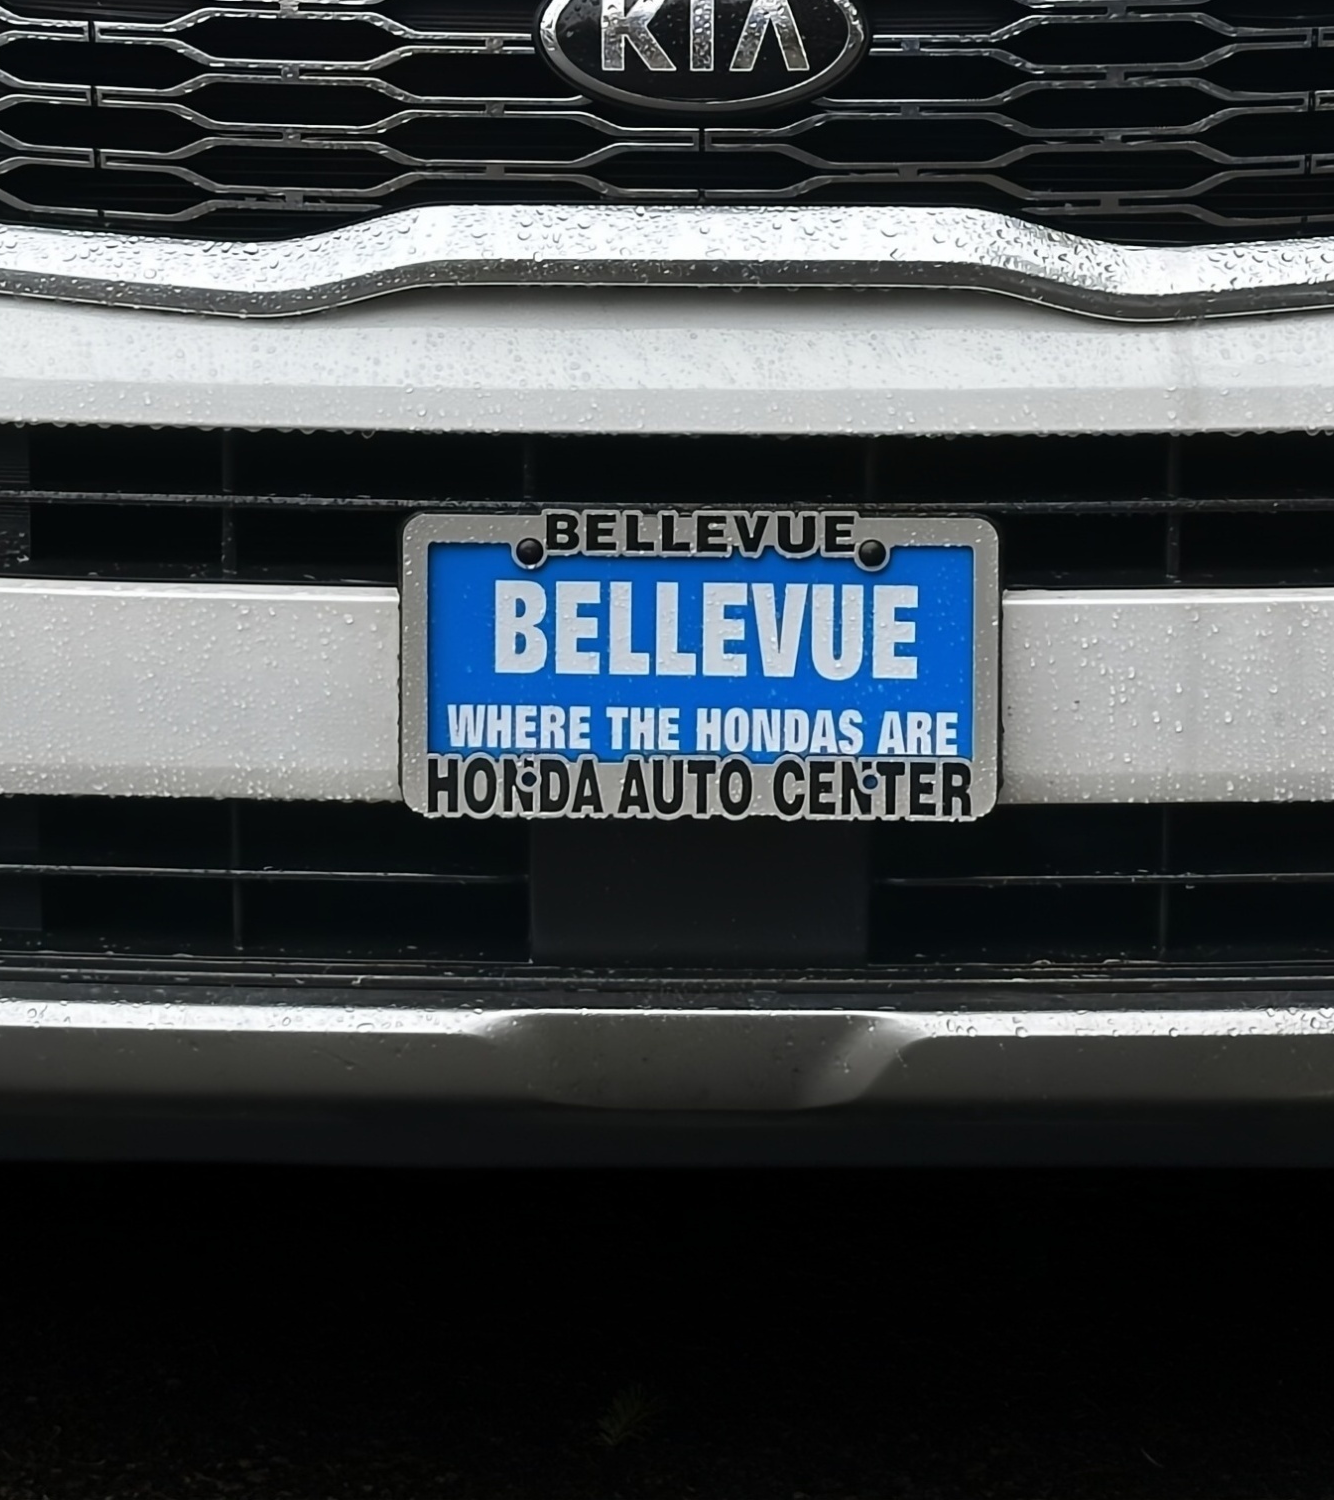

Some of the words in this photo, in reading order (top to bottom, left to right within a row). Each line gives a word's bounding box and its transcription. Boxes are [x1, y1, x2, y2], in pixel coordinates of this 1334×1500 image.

[544, 513, 855, 553] BELLEVUE
[493, 578, 919, 681] BELLEVUE
[447, 703, 591, 750] WHERE
[606, 705, 680, 750] THE
[695, 708, 864, 755] HONDAS
[877, 710, 959, 756] ARE
[427, 757, 604, 813] HONDA
[617, 758, 753, 816] AUTO
[773, 759, 972, 816] CENTER
